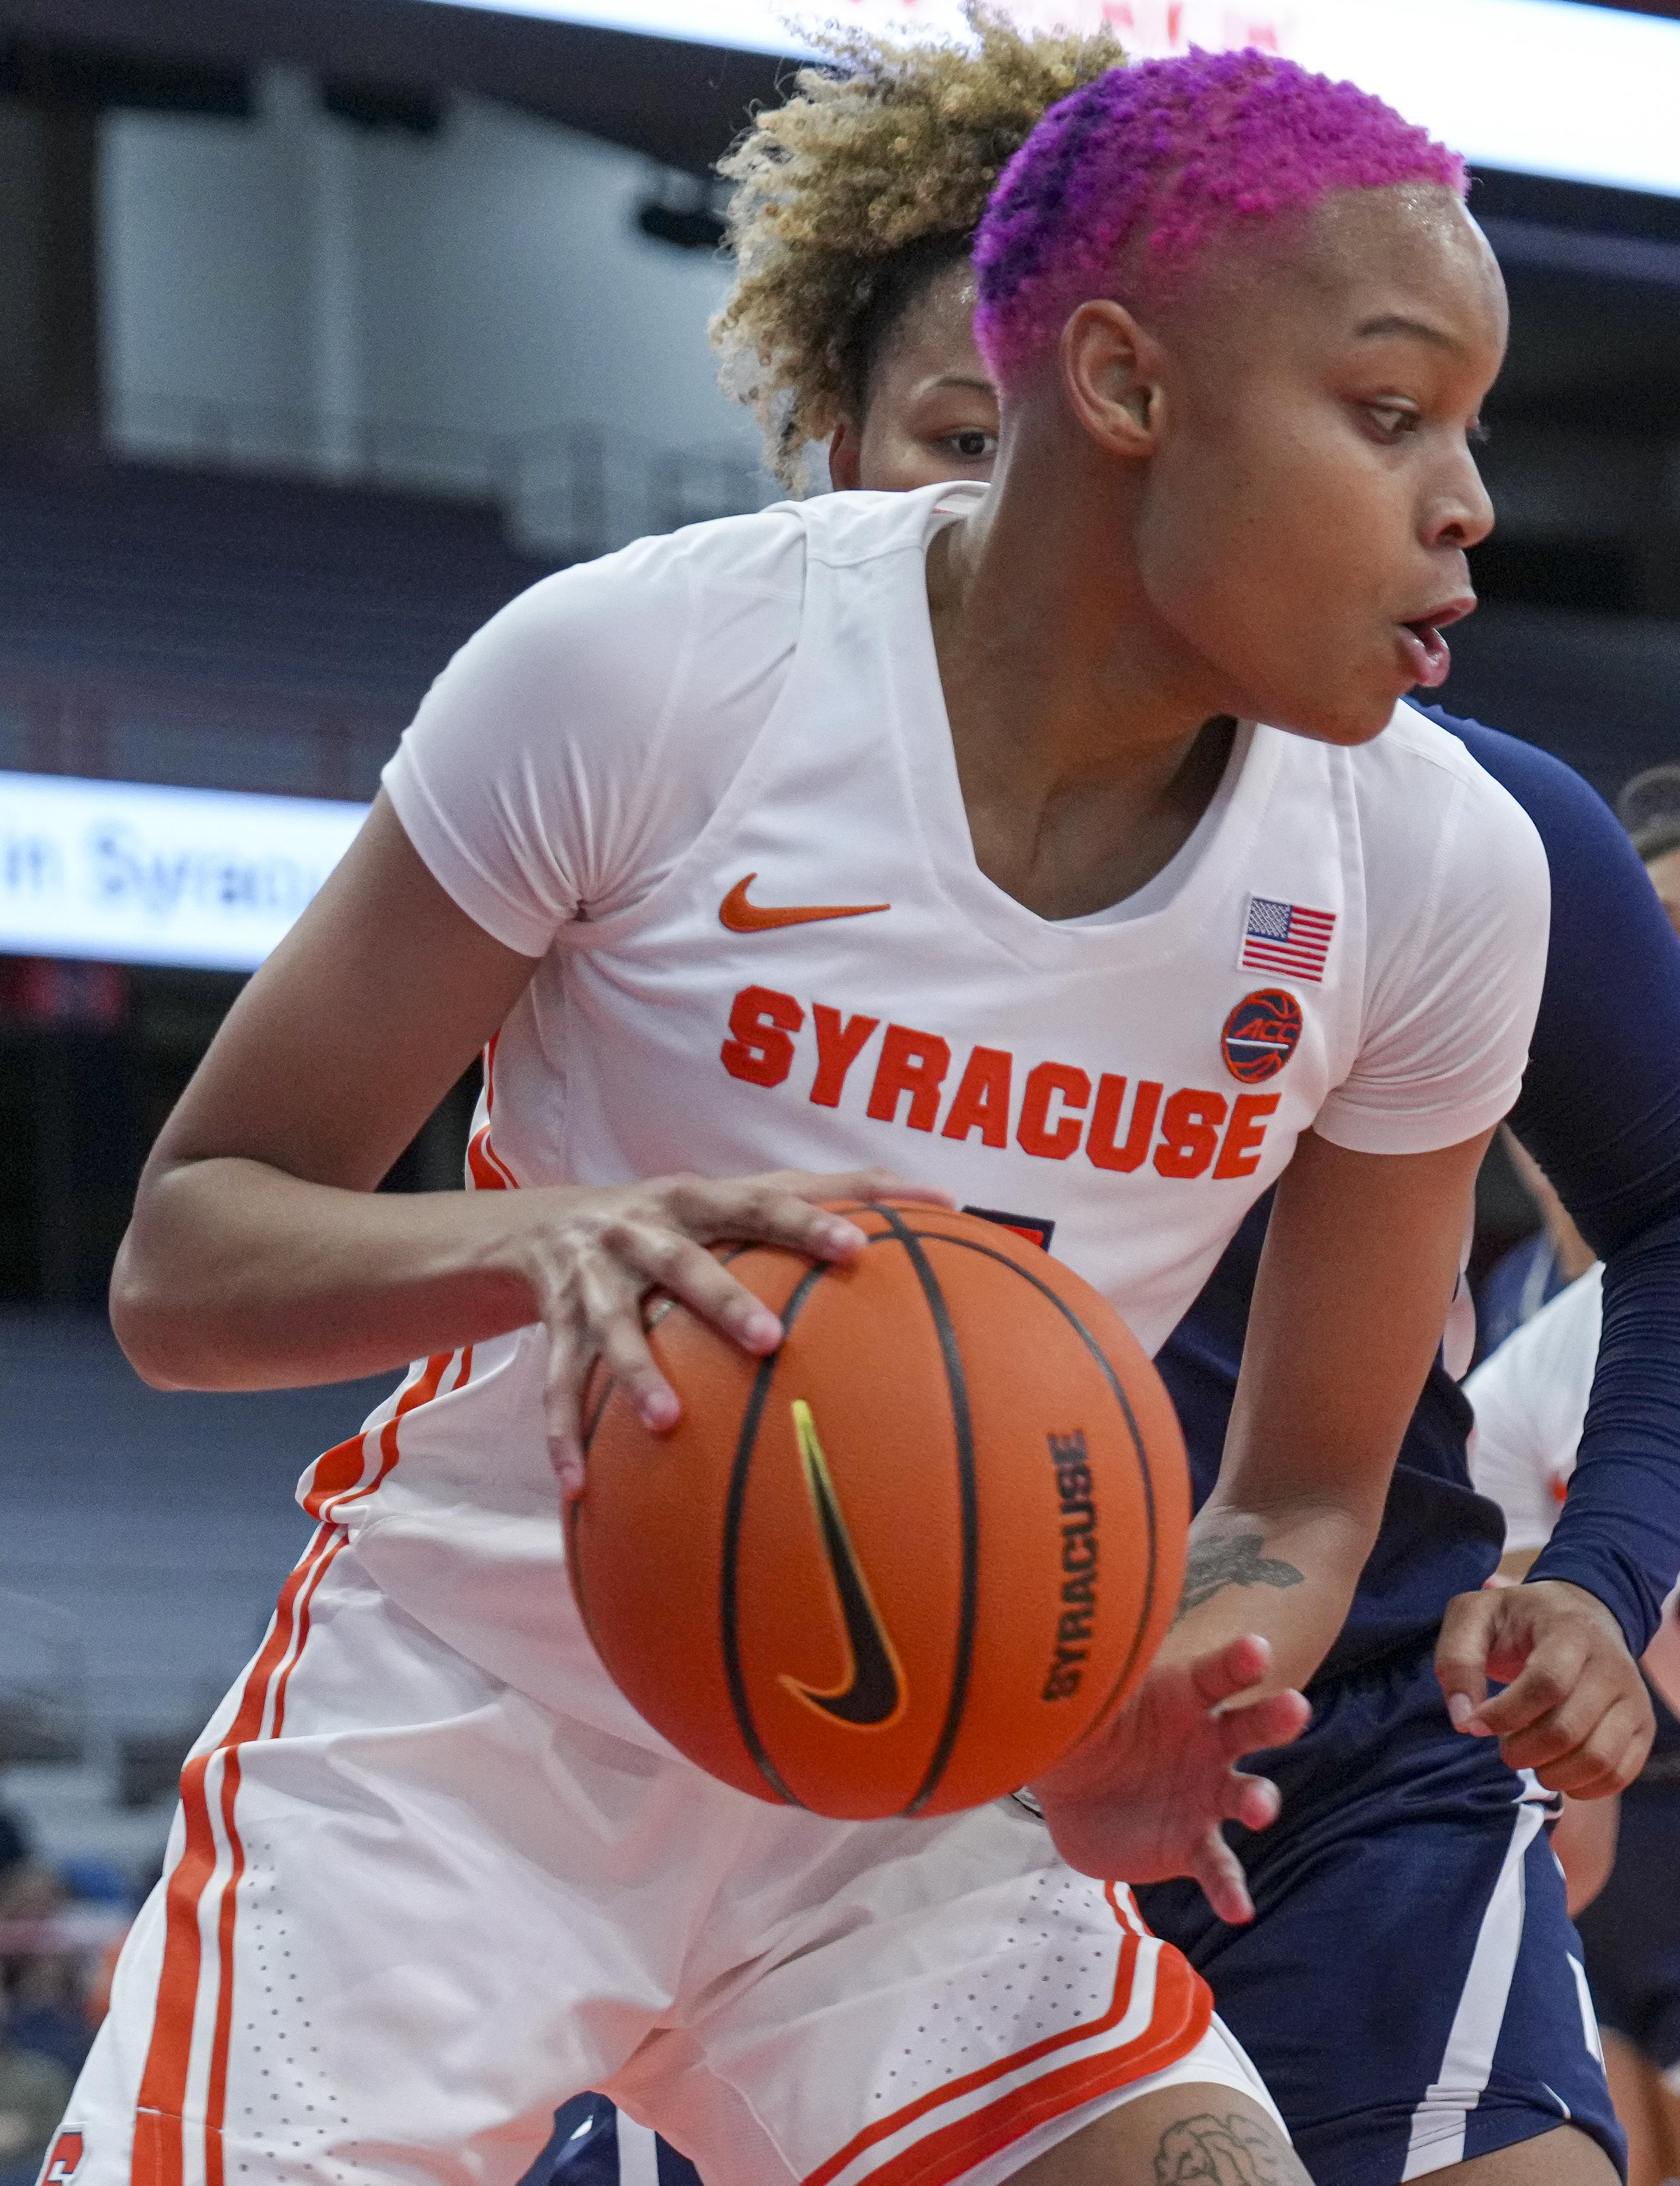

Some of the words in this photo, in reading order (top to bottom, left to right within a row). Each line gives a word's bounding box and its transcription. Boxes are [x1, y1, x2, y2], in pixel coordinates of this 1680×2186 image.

[720, 985, 1281, 1180] SYRACUSE
[1235, 1018, 1302, 1043] ACC
[1042, 1428, 1098, 1703] SYRACUSE
